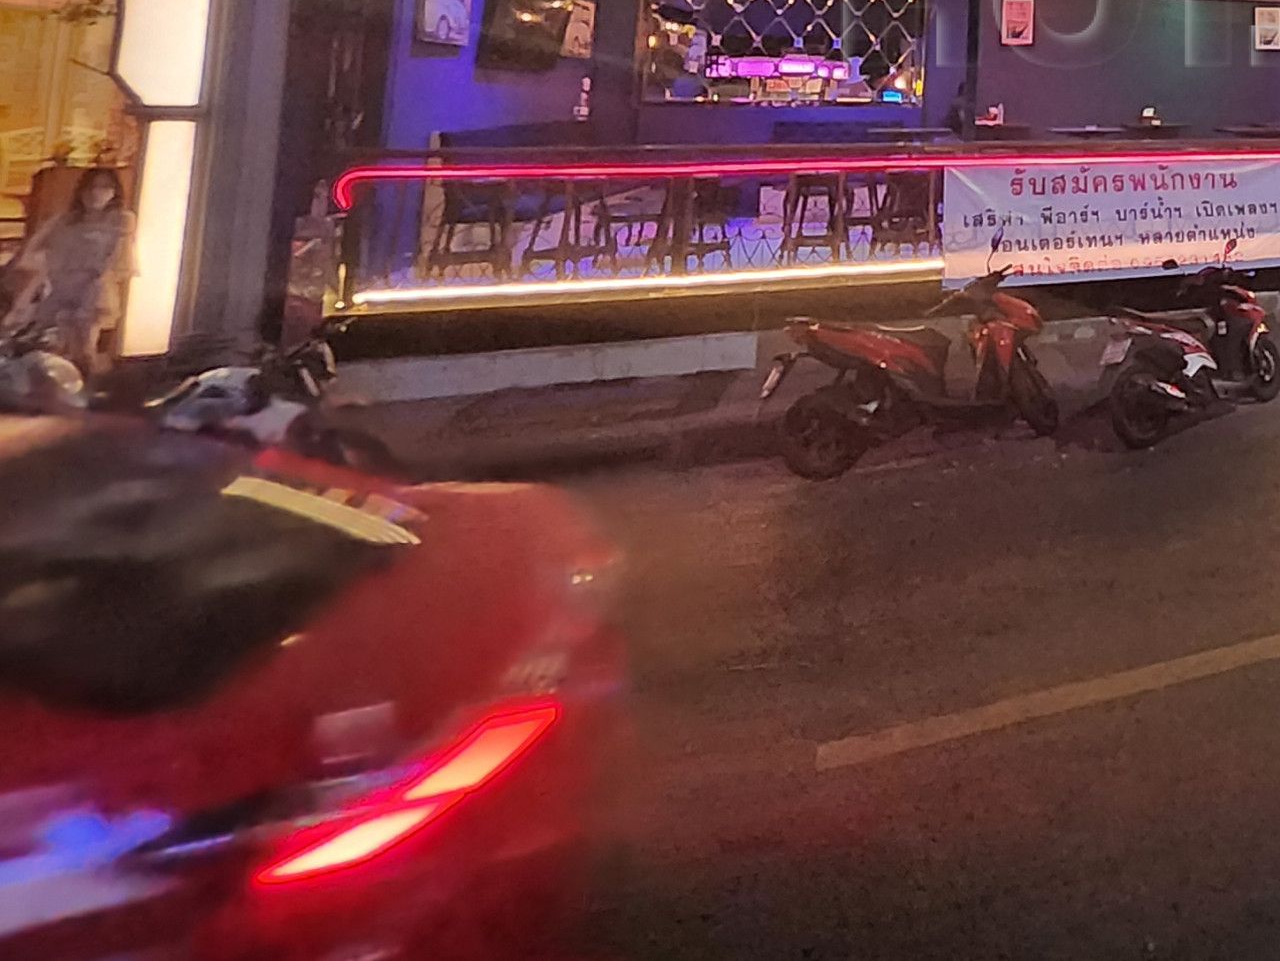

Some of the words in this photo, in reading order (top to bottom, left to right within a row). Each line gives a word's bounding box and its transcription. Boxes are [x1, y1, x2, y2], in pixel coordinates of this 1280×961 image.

[1009, 165, 1238, 197] รับสมัครพนักงาน
